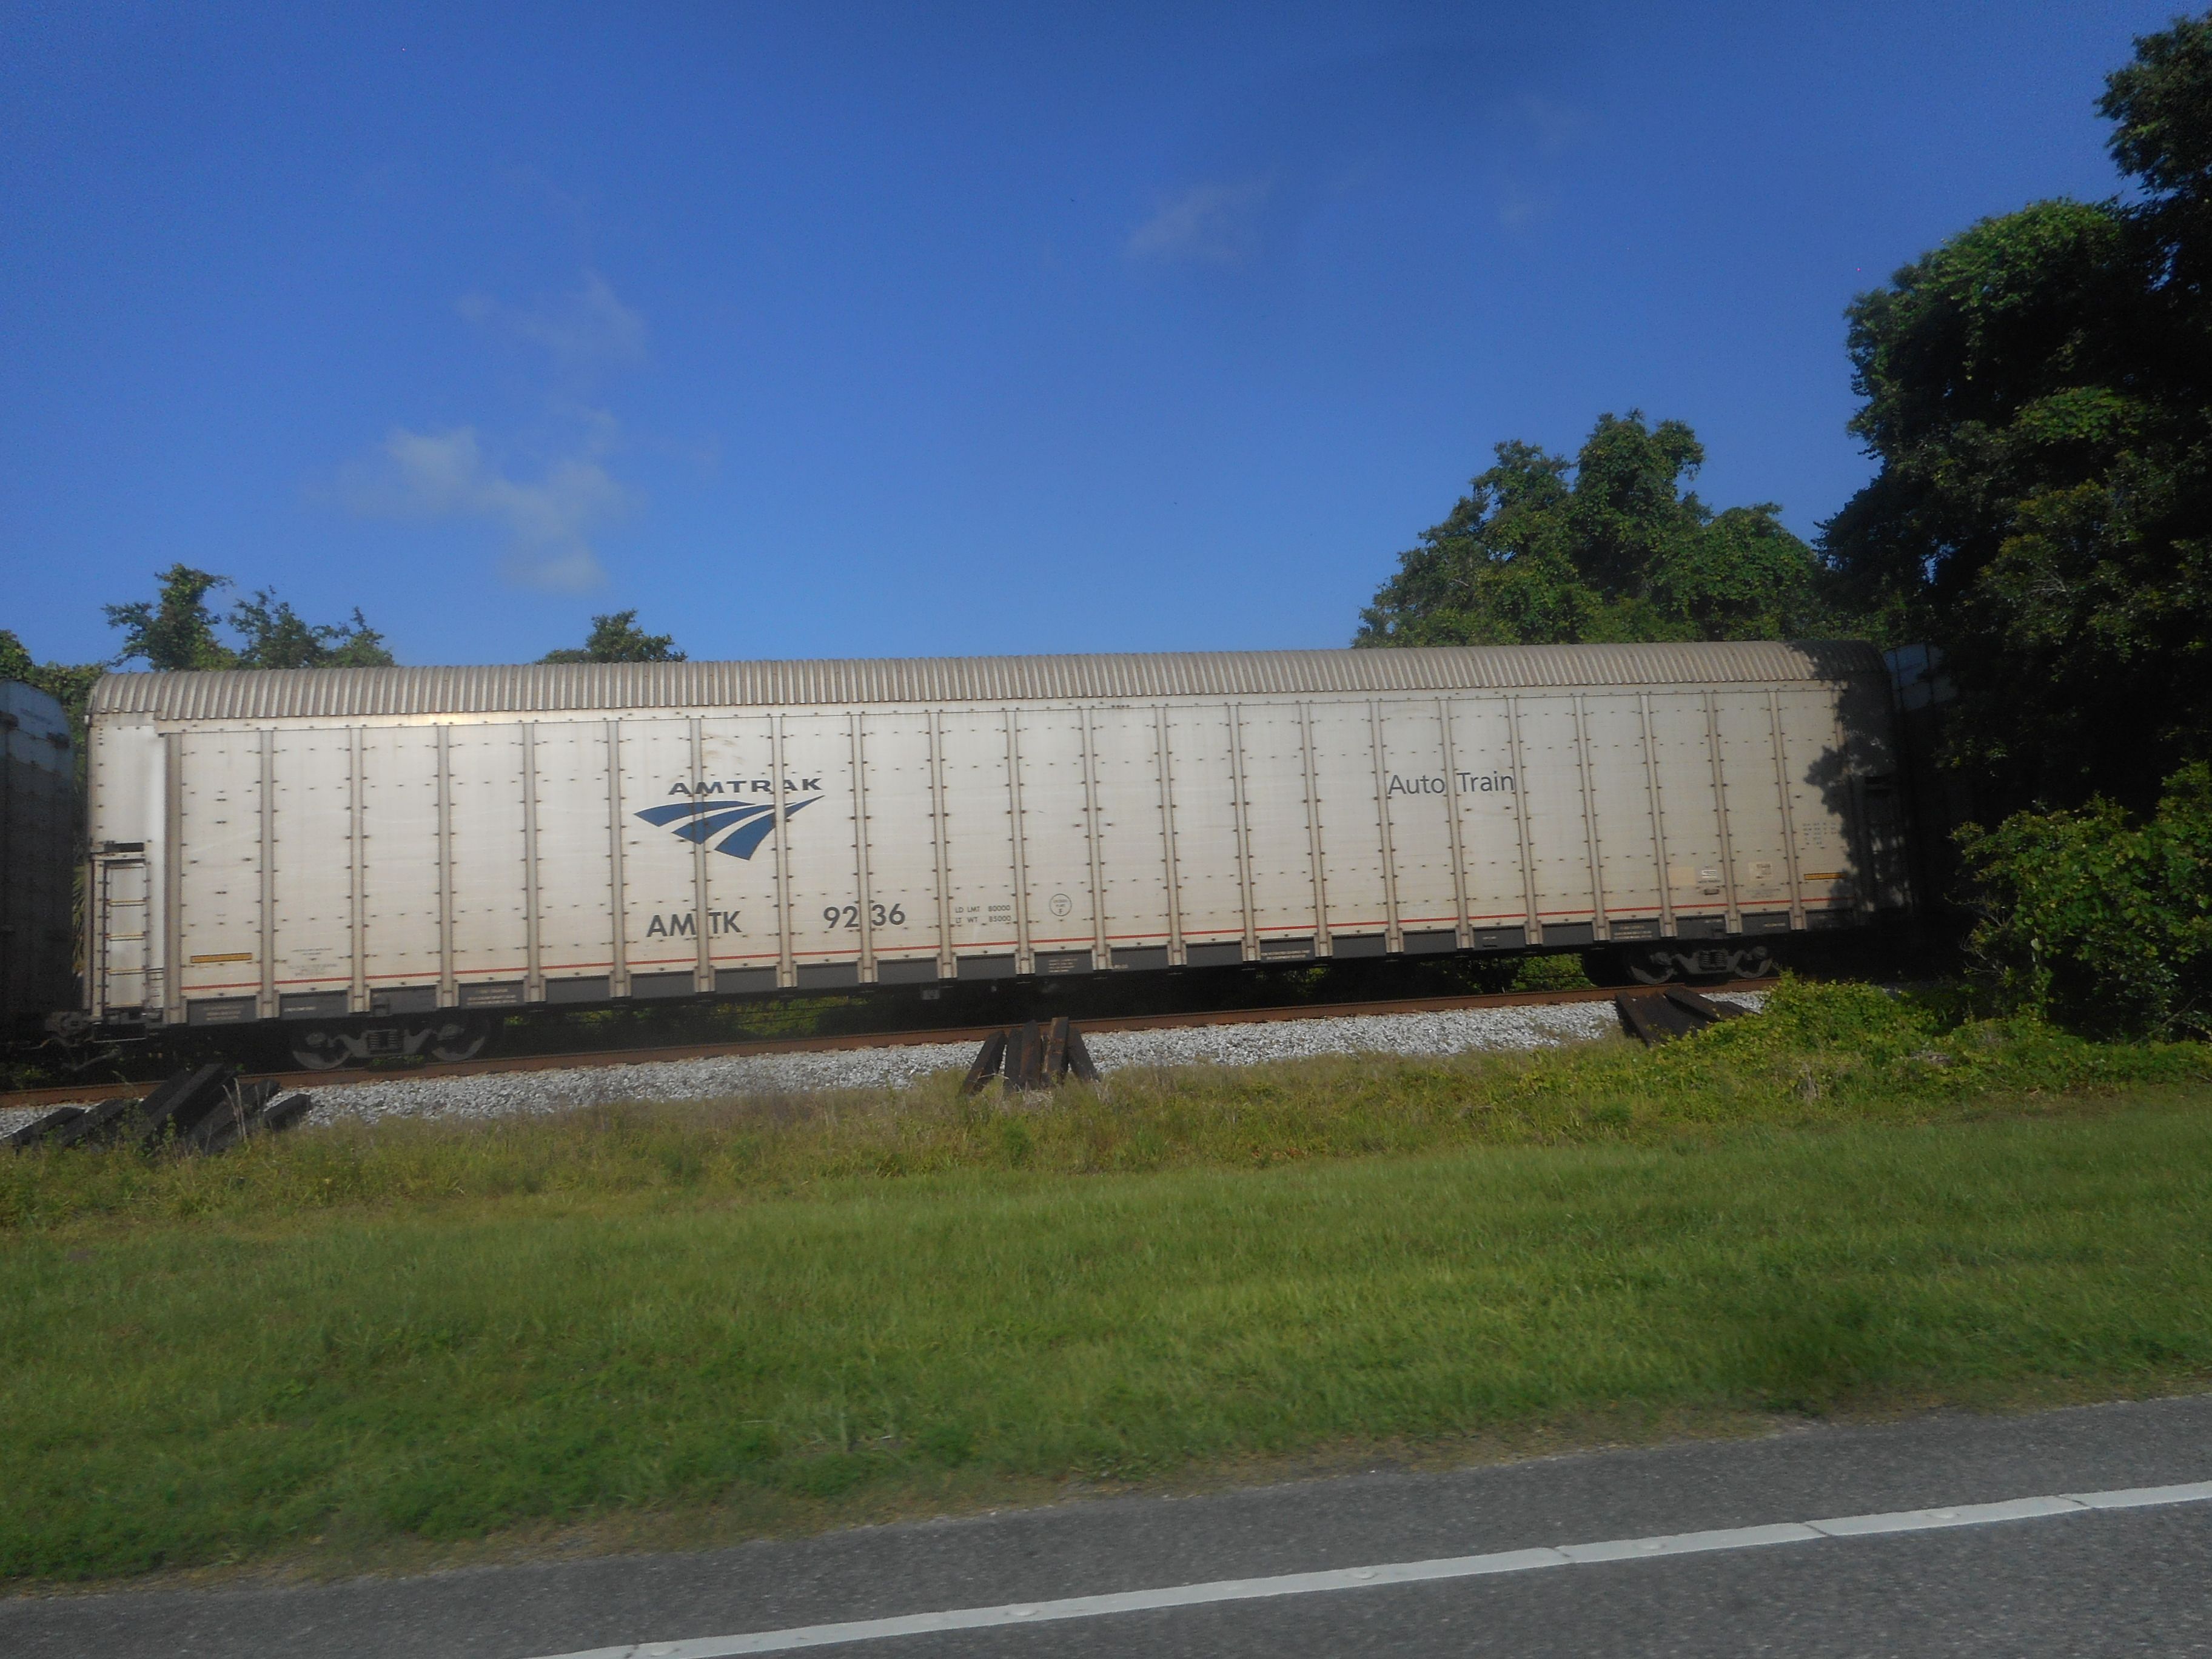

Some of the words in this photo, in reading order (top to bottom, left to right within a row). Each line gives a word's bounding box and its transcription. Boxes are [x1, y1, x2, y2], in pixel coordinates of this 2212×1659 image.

[668, 778, 824, 796] AMTRAK
[1388, 774, 1446, 795] Auto
[1456, 771, 1515, 793] Train
[823, 903, 906, 929] 9236
